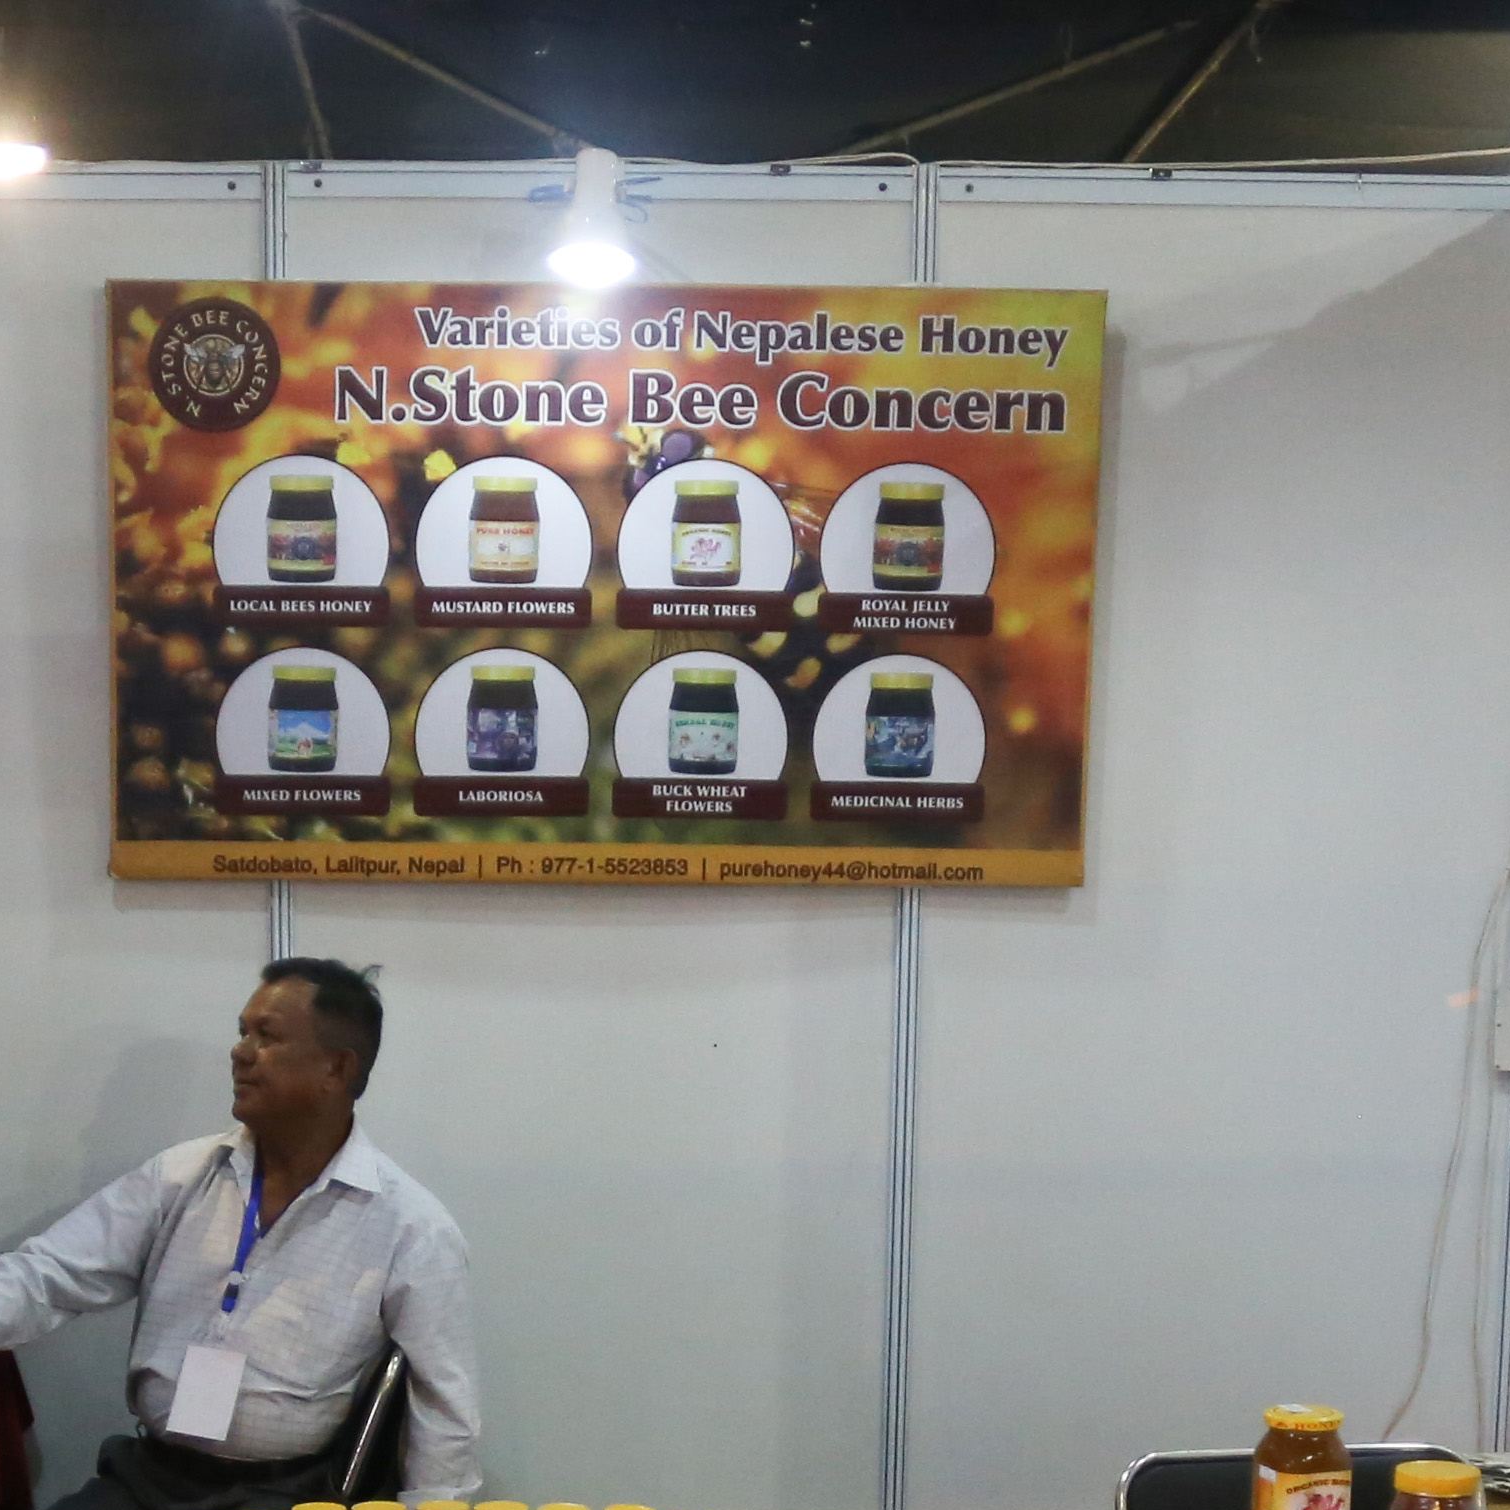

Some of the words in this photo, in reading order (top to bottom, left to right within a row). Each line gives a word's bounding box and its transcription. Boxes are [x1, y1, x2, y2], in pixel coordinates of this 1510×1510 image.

[414, 305, 620, 350] Varieties
[632, 308, 685, 351] of
[695, 310, 904, 365] Nepalese
[920, 315, 1068, 368] Honey
[335, 365, 608, 426] N.Stone
[630, 368, 757, 428] Bee
[777, 370, 1067, 434] Concern
[229, 600, 276, 613] LOCAL
[281, 600, 316, 613] BEES
[320, 600, 372, 613] HONEY
[432, 601, 503, 614] MUSTARD
[507, 602, 575, 614] FLOWERS
[652, 603, 710, 616] BUTTER
[713, 604, 756, 617] TREES
[861, 599, 907, 612] ROYAL
[911, 600, 949, 613] JELLY
[853, 617, 901, 629] MIXED
[905, 617, 957, 630] HONEY
[243, 790, 290, 801] MIXED
[294, 790, 362, 802] FLOWERS
[458, 790, 543, 802] LABORIOSA
[652, 784, 693, 797] BUCK
[697, 785, 747, 798] WHEAT
[666, 800, 732, 812] FLOWERS
[831, 795, 912, 808] MEDICINAL
[917, 796, 964, 809] HERBS
[213, 855, 318, 876] Satdobato,
[325, 855, 400, 877] Lalitpur,
[408, 856, 465, 877] Nepal
[496, 856, 522, 873] Ph
[541, 856, 688, 875] 977-1-5523853
[720, 861, 984, 881] purehoney44@hotmail.com
